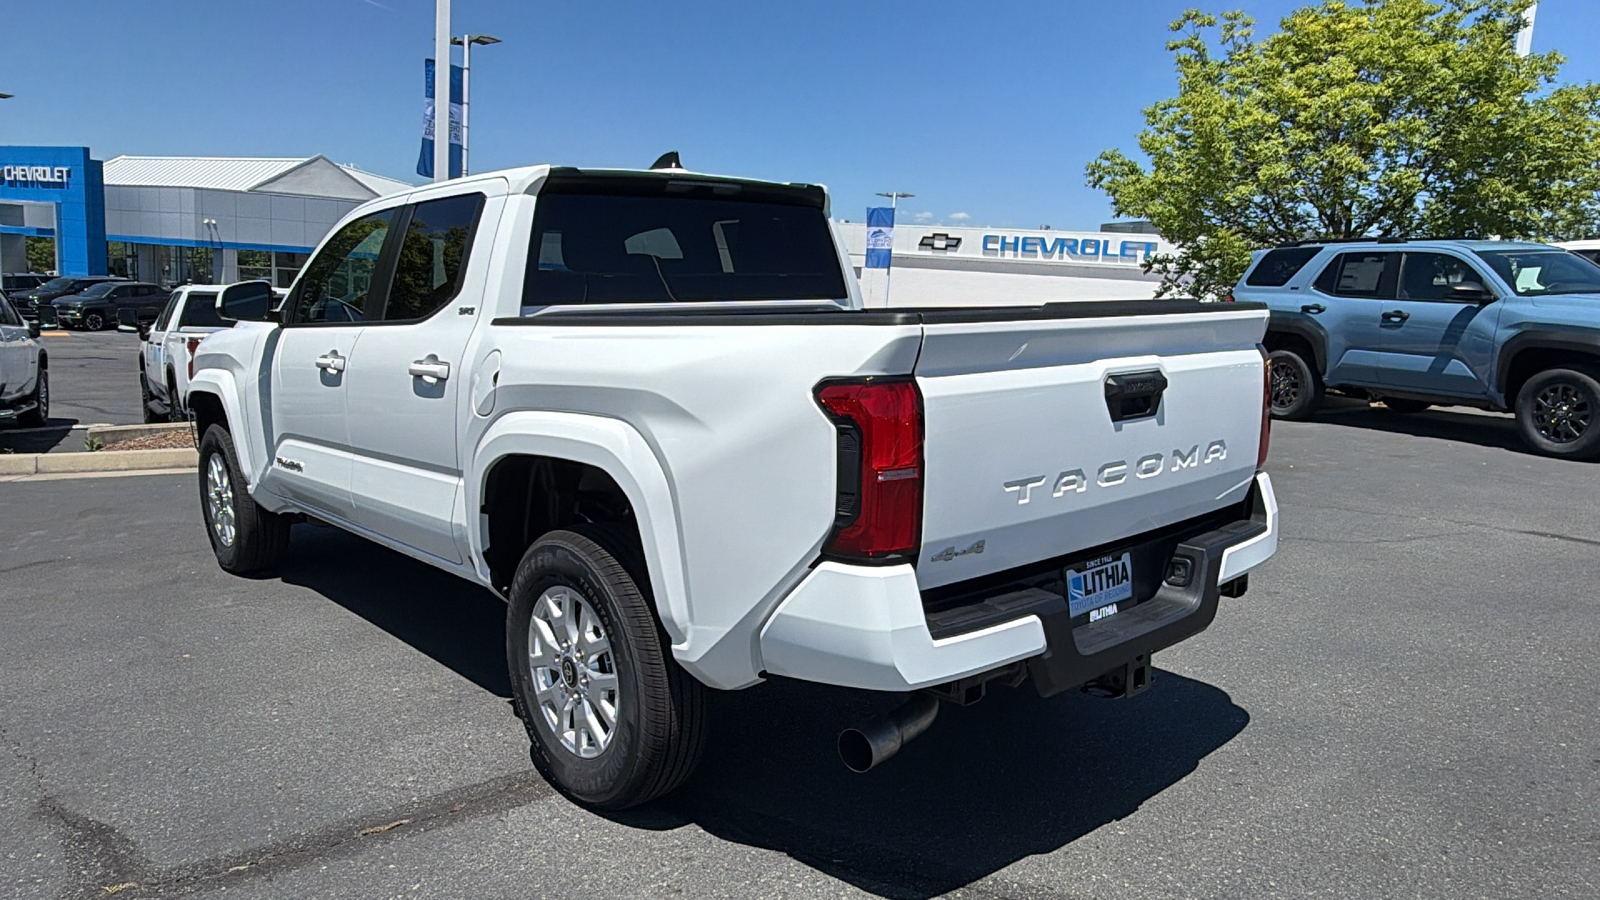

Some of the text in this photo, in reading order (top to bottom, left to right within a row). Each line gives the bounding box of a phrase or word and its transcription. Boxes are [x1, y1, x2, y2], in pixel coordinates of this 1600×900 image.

[4, 166, 67, 182] CHEVROLET
[982, 234, 1158, 258] CHEVROLET
[1003, 439, 1227, 504] TACOMA
[1083, 562, 1129, 596] LITHIA
[1070, 597, 1094, 611] TOYOTA
[1094, 593, 1104, 604] OF
